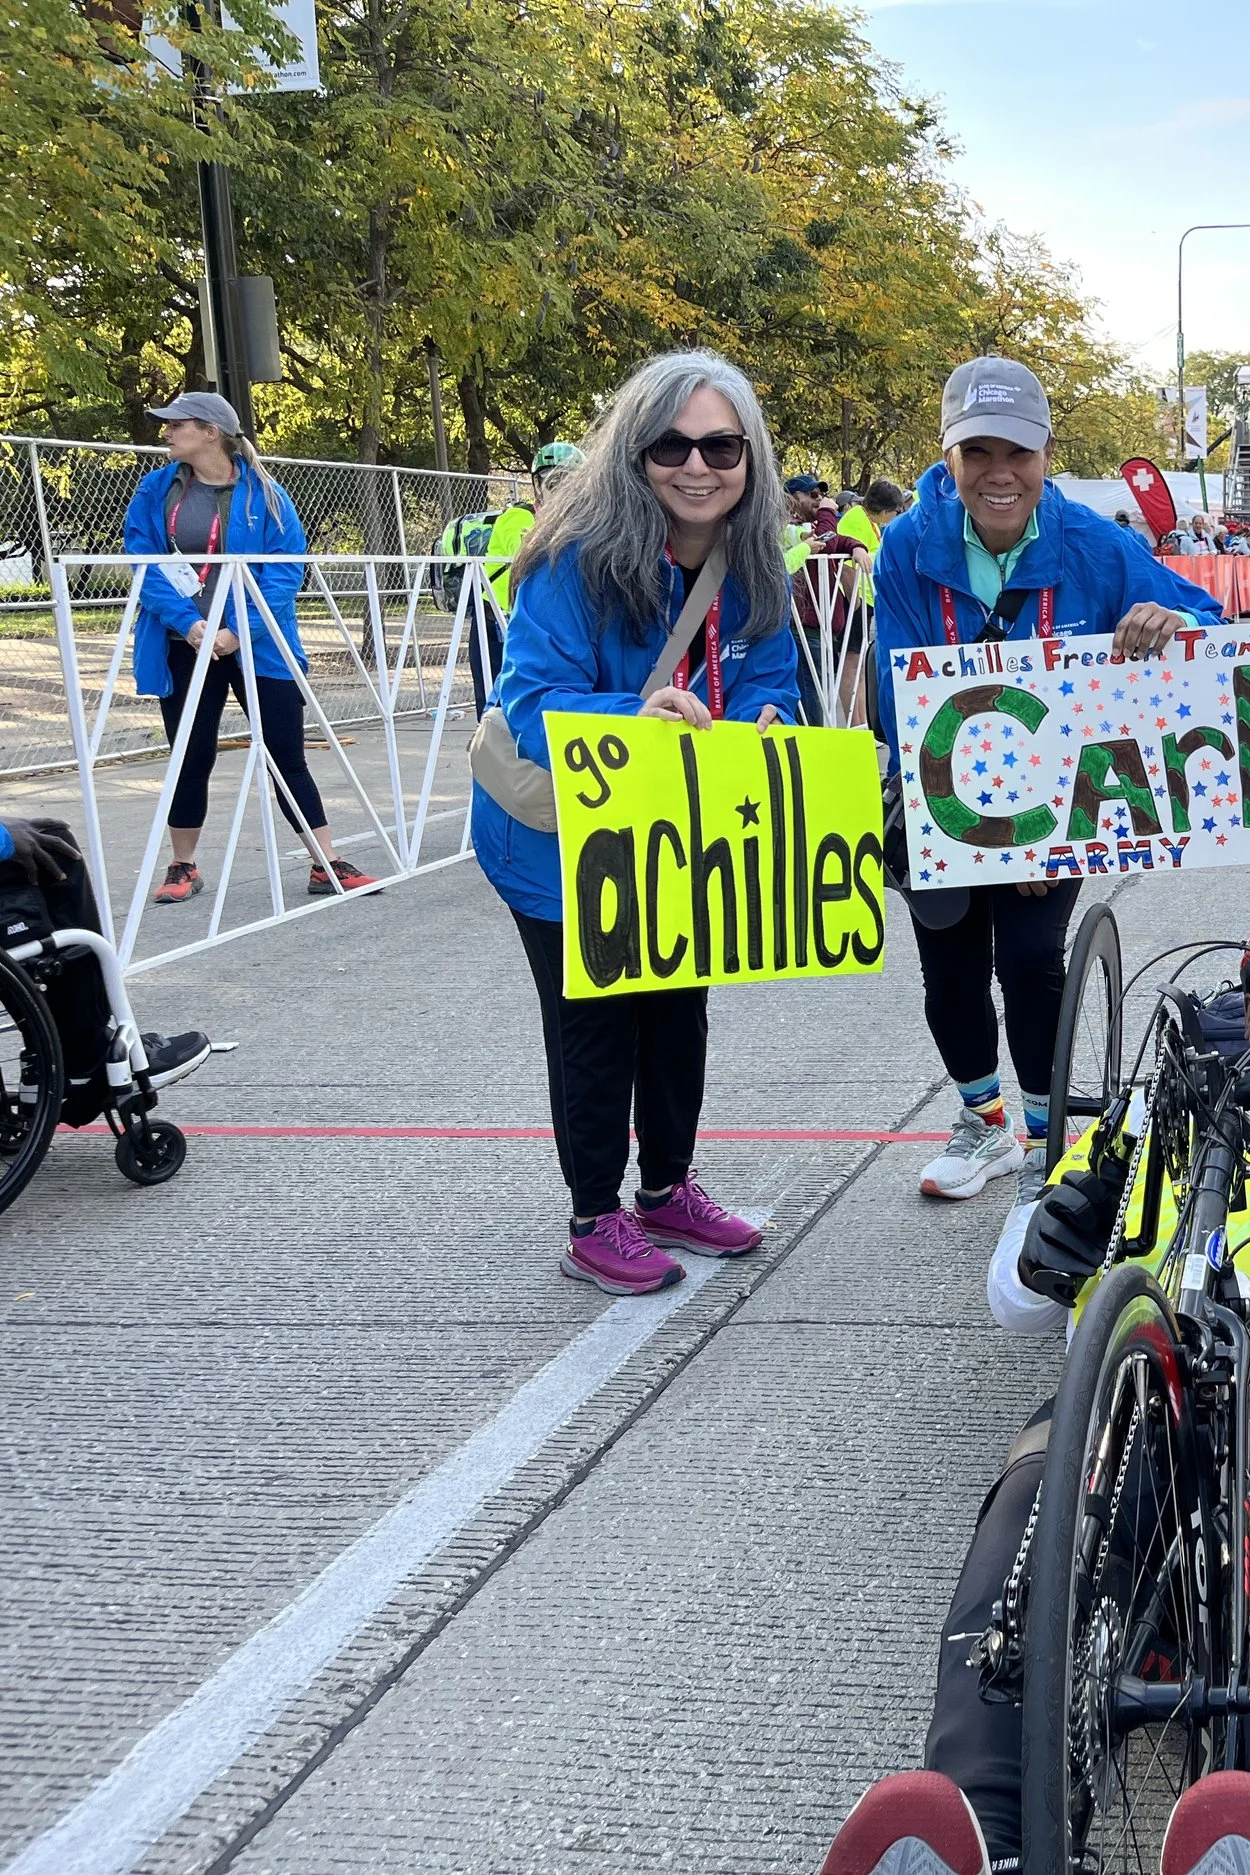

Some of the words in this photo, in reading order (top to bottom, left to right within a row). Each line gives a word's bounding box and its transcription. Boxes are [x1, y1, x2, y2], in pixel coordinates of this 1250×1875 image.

[978, 389, 1008, 397] Chicago
[711, 641, 719, 676] AMERICA
[905, 643, 1034, 682] Achilles
[713, 676, 720, 687] OF
[564, 733, 631, 809] go
[575, 732, 884, 990] achilles
[1045, 836, 1191, 879] ARMY
